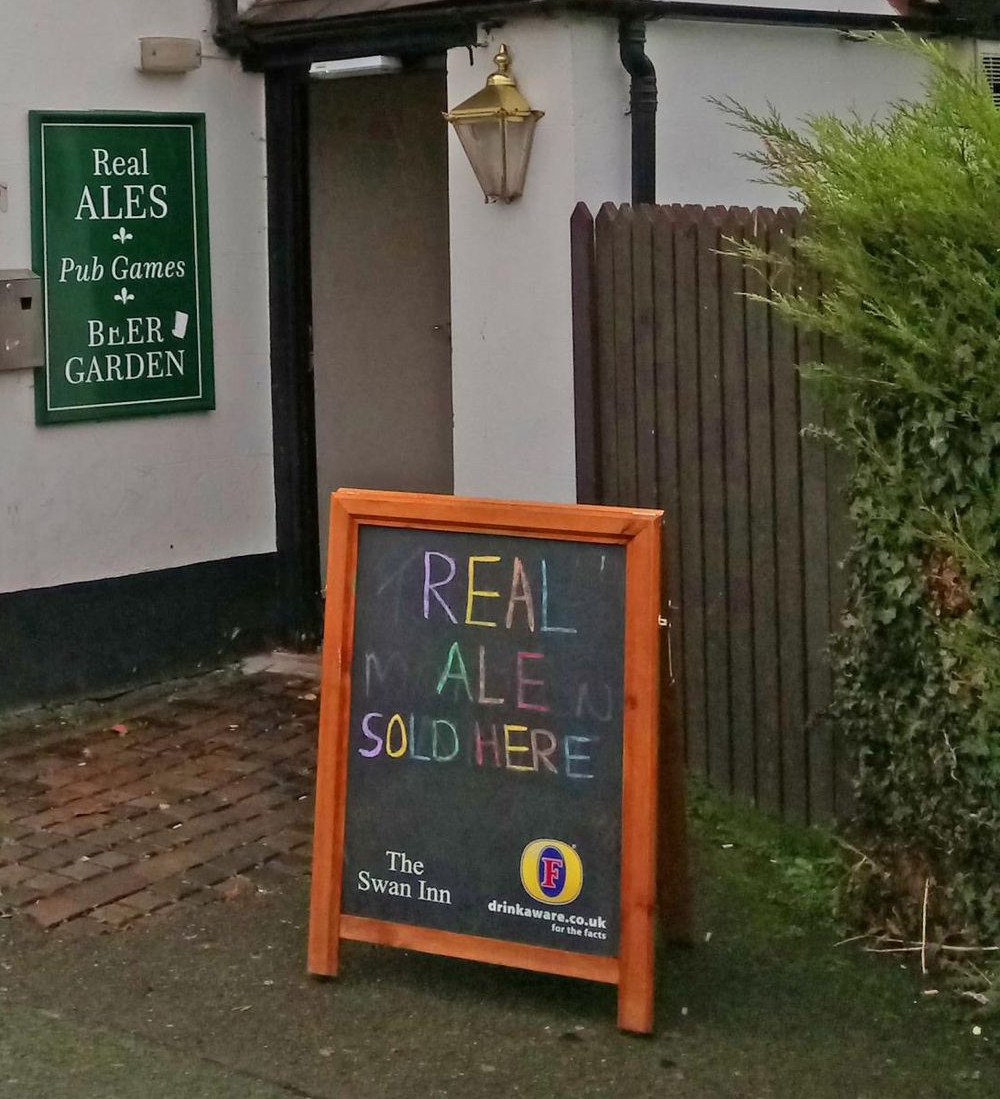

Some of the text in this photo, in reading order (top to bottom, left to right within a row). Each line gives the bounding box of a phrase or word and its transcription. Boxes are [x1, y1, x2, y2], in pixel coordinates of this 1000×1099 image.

[92, 148, 150, 176] Real
[74, 184, 168, 220] ALES
[59, 255, 186, 282] Pub Games
[87, 316, 164, 347] BEER
[65, 349, 185, 384] GARDEN
[423, 551, 577, 633] REAL
[436, 641, 548, 711] ALE
[358, 712, 595, 779] SOLD HERE
[386, 850, 424, 875] The
[358, 870, 452, 905] Swan Inn
[487, 900, 607, 929] drinkaware.co.uk
[551, 923, 607, 940] for the facts
